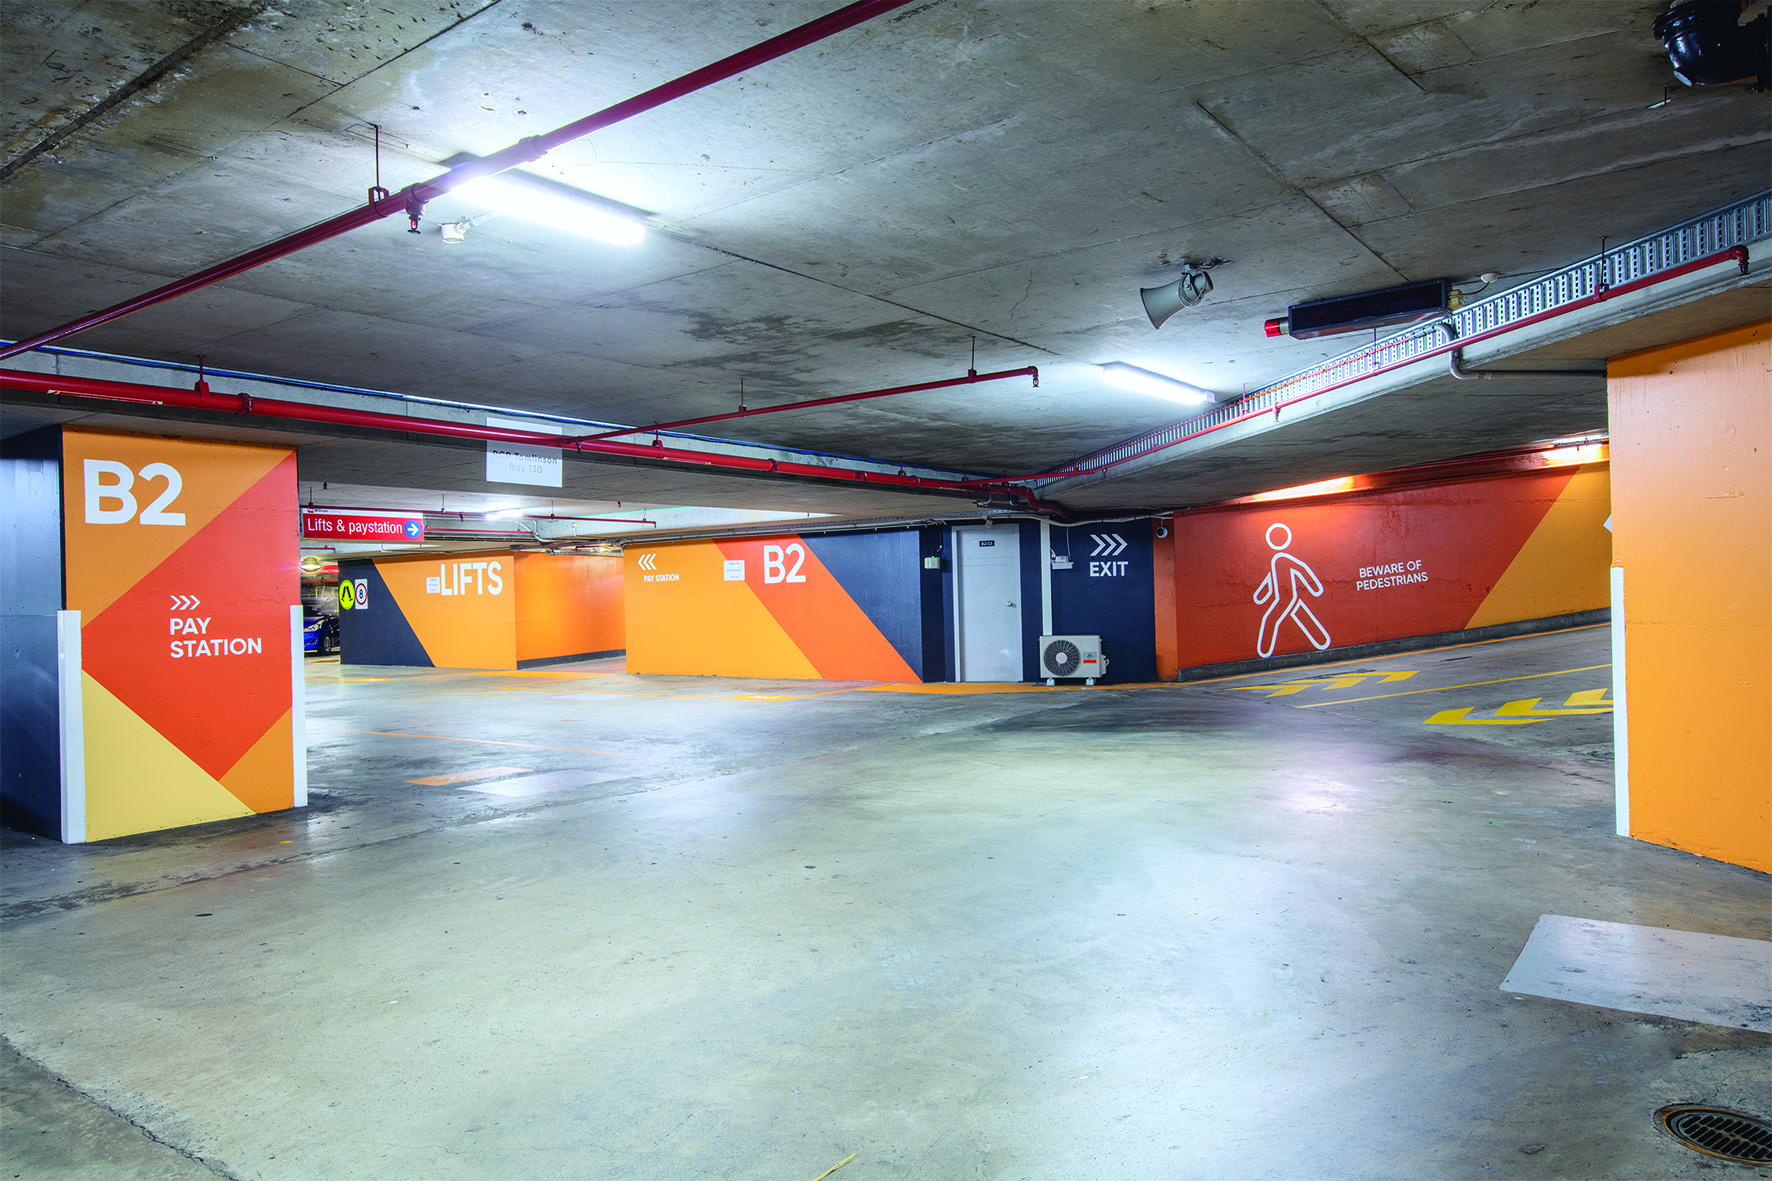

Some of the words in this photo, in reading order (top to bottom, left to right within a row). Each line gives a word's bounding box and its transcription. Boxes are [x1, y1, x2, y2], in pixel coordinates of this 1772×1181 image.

[513, 452, 558, 465] Tomlinson
[508, 463, 525, 474] Bay
[528, 464, 543, 474] 130
[84, 459, 186, 526] B2
[307, 518, 332, 532] Lifts
[336, 519, 345, 532] &
[349, 521, 403, 536] paystation
[763, 543, 806, 584] B2
[1089, 561, 1128, 577] EXIT
[1359, 562, 1405, 578] BEWARE
[1406, 560, 1422, 571] OF
[440, 561, 503, 597] LIFTS
[643, 575, 654, 583] PAY
[655, 573, 680, 582] STATION
[1356, 571, 1429, 591] PEDESTRIANS
[359, 589, 364, 599] 8
[170, 617, 211, 636] PAY
[170, 637, 262, 659] STATION
